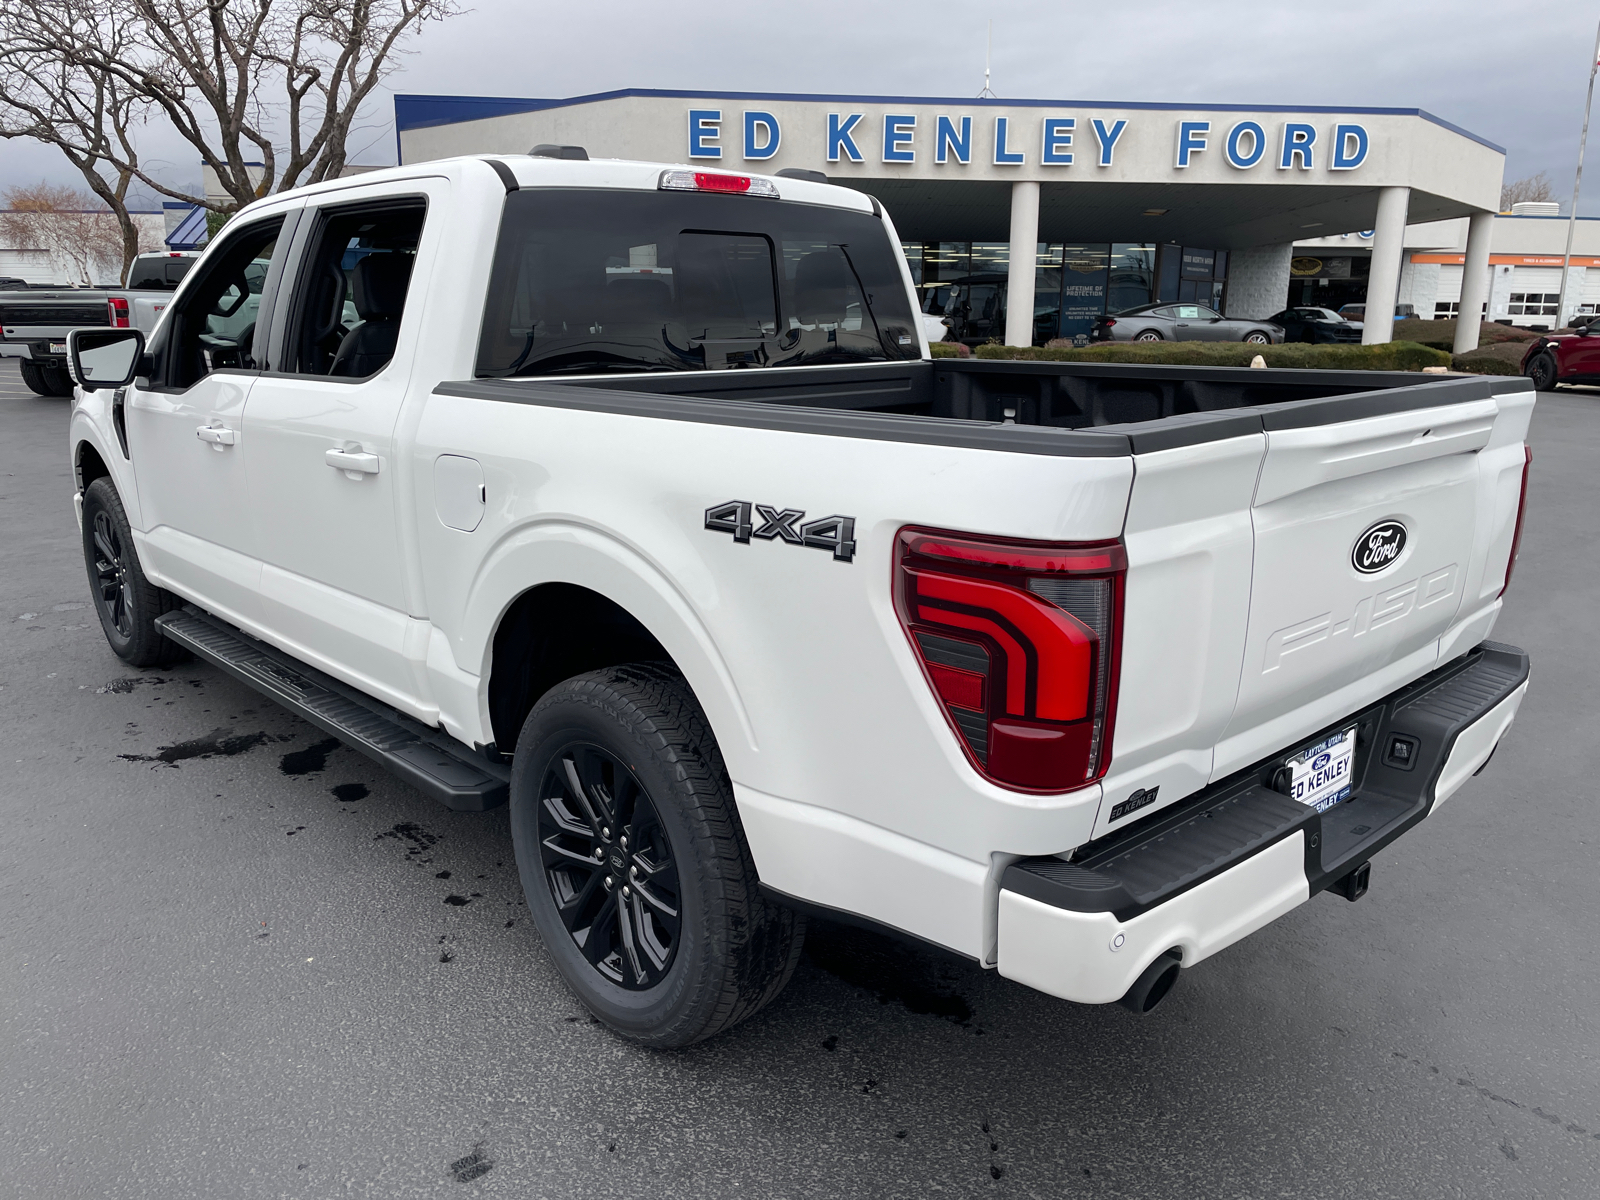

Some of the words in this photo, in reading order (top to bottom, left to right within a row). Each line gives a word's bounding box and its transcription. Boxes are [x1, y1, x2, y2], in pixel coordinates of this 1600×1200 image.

[688, 109, 781, 160] ED
[826, 112, 1129, 167] KENLEY
[1174, 120, 1370, 170] FORD
[1363, 529, 1401, 566] Ford
[1262, 562, 1459, 675] F-150
[1328, 732, 1342, 748] UTAH
[1308, 756, 1350, 793] KENLEY
[1111, 806, 1123, 820] ED
[1124, 790, 1158, 813] KENLEY
[1315, 793, 1339, 815] ENLEY
